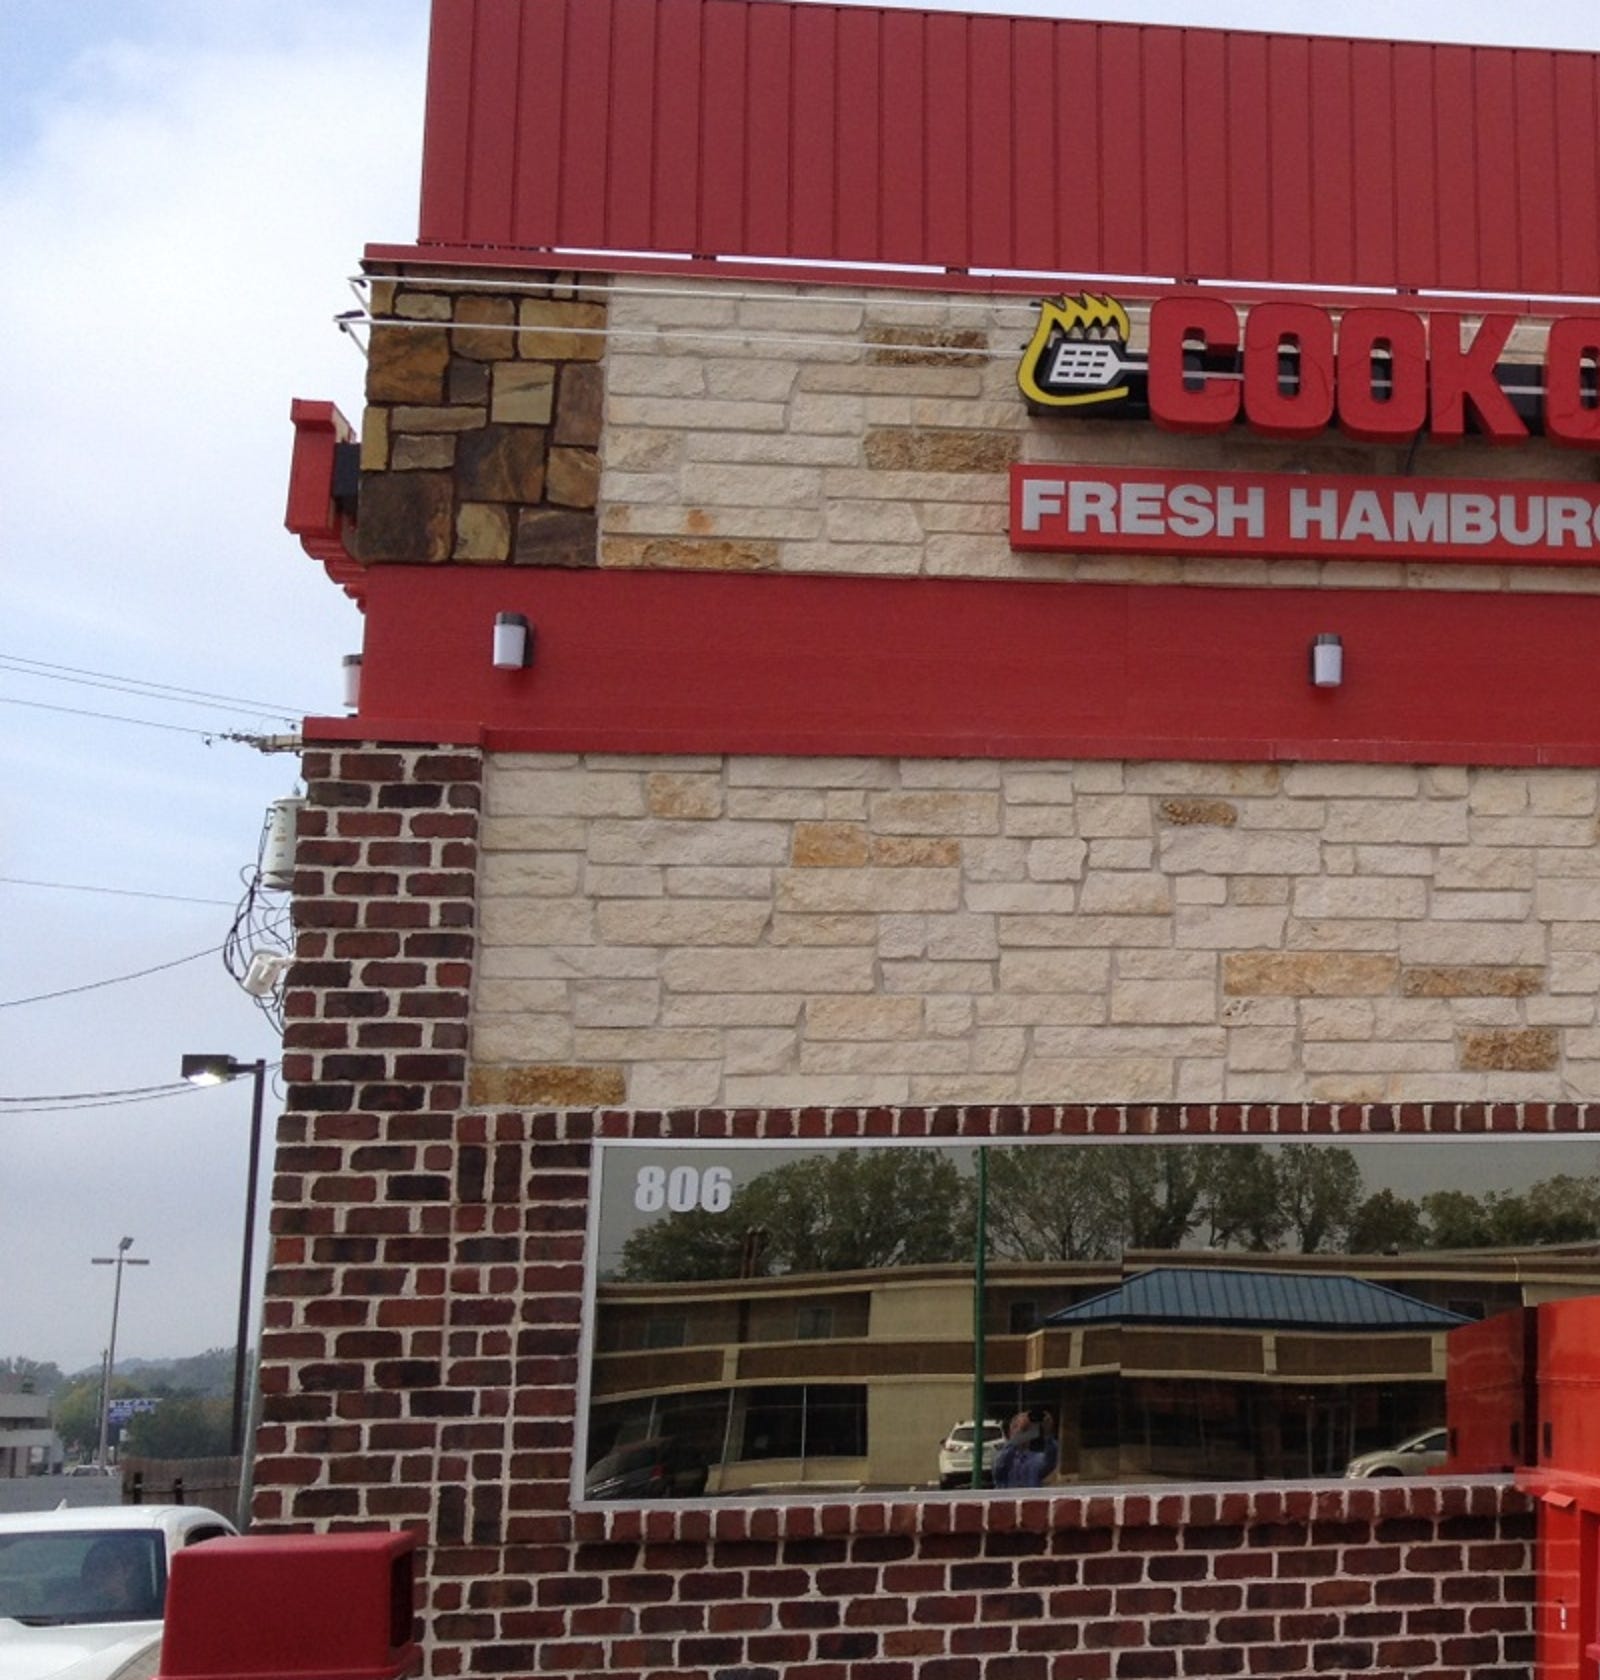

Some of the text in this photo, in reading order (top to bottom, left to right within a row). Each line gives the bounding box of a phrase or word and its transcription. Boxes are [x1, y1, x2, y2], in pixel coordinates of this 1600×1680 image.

[1148, 297, 1530, 444] COOK
[1022, 479, 1265, 538] FRESH
[635, 1165, 733, 1213] 806
